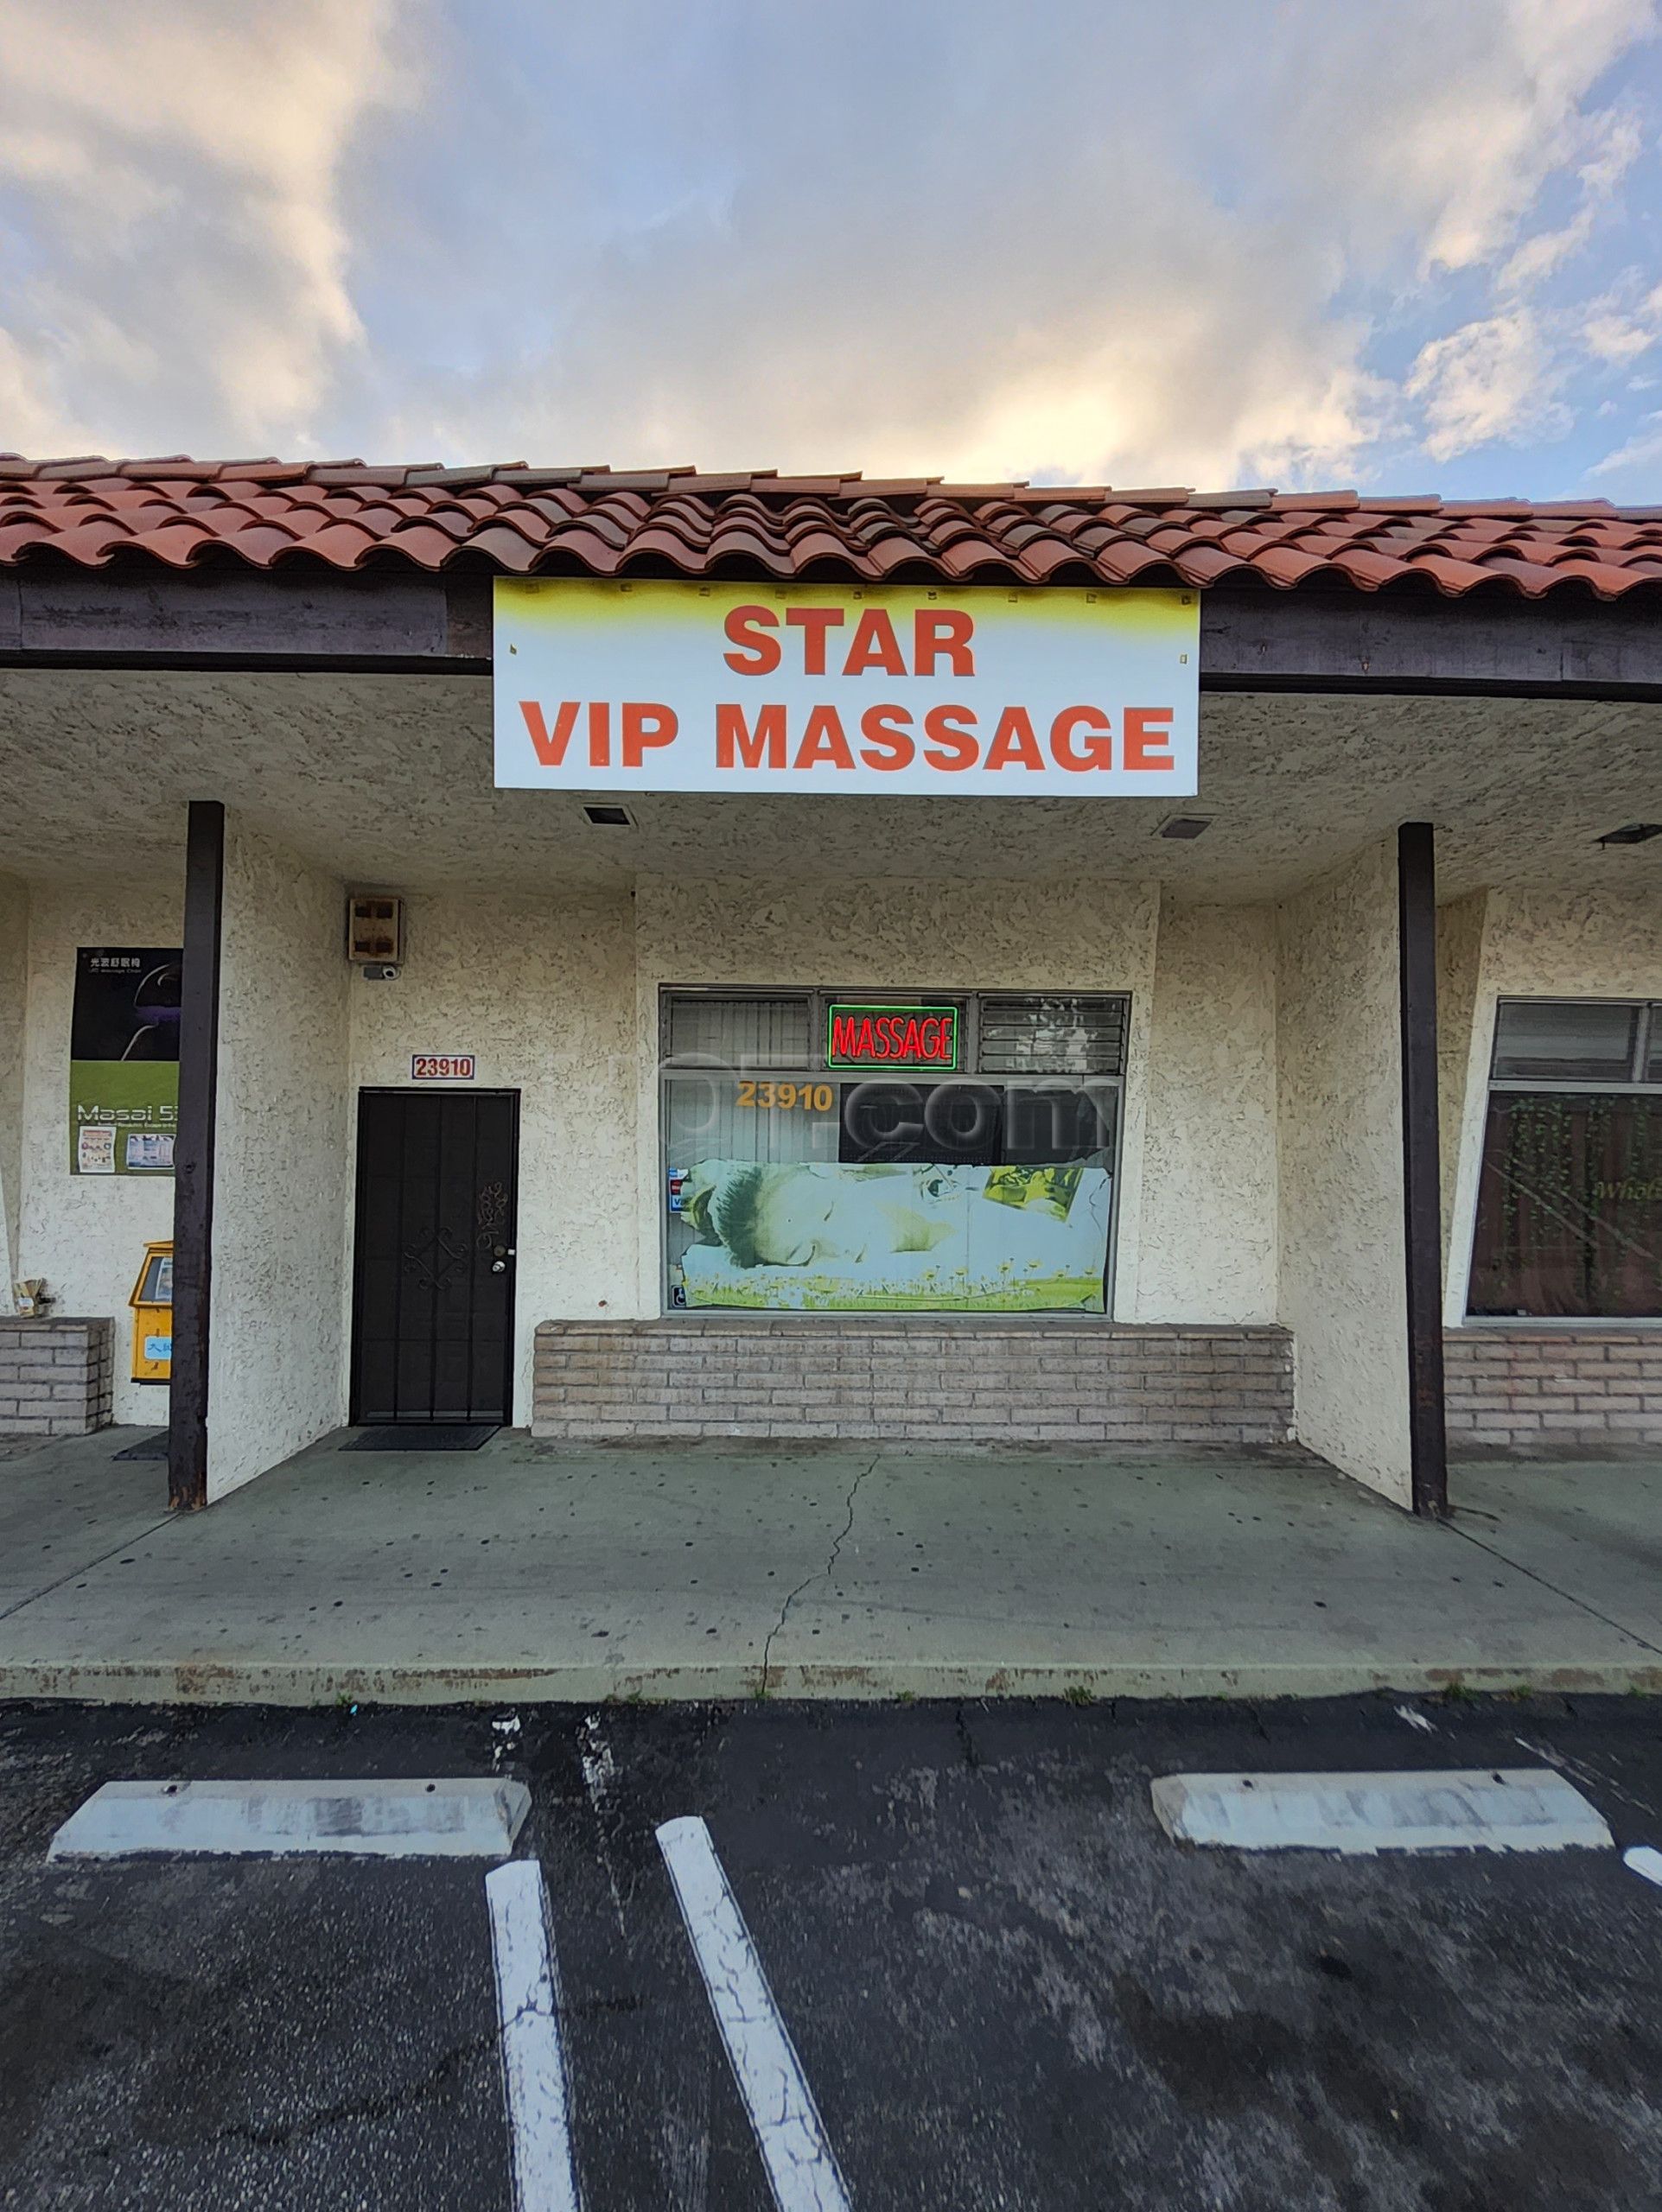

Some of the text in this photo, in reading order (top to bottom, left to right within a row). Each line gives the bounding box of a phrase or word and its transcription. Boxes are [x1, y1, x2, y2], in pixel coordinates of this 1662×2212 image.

[723, 605, 975, 677] STAR
[519, 701, 1175, 772] VIP MASSAGE
[832, 1015, 952, 1059] MASSAGE
[415, 1058, 472, 1077] 23910
[78, 1104, 152, 1121] Masai
[735, 1080, 833, 1111] 23910
